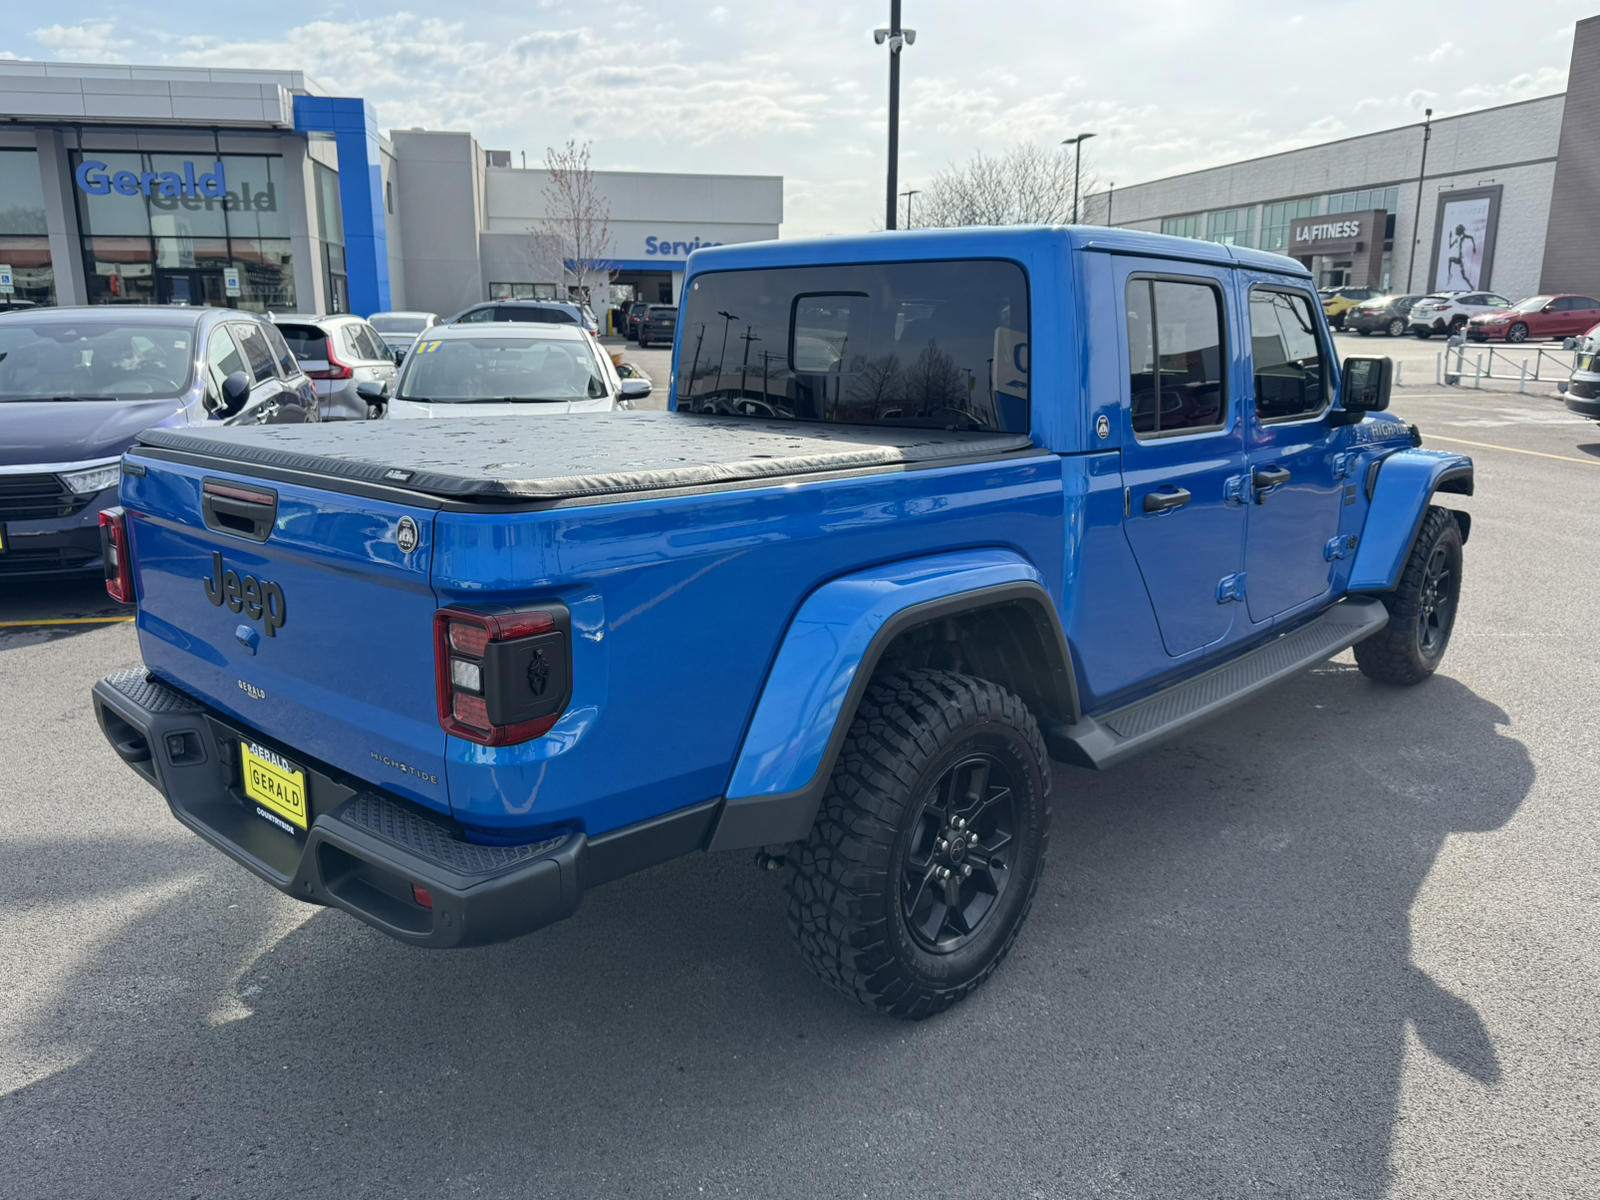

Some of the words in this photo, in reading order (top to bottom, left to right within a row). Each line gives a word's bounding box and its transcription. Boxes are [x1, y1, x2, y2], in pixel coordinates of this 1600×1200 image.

[75, 160, 227, 197] Gerald
[1296, 226, 1309, 241] LA
[1311, 221, 1360, 240] FITNESS
[417, 341, 442, 354] 17
[203, 550, 286, 638] Jeep
[238, 680, 266, 699] GERALD
[251, 743, 289, 771] GERALD
[370, 751, 400, 769] HIGH
[409, 767, 439, 785] TIDE
[253, 769, 299, 807] GERALD
[256, 807, 294, 834] COUNTRYSIDE
